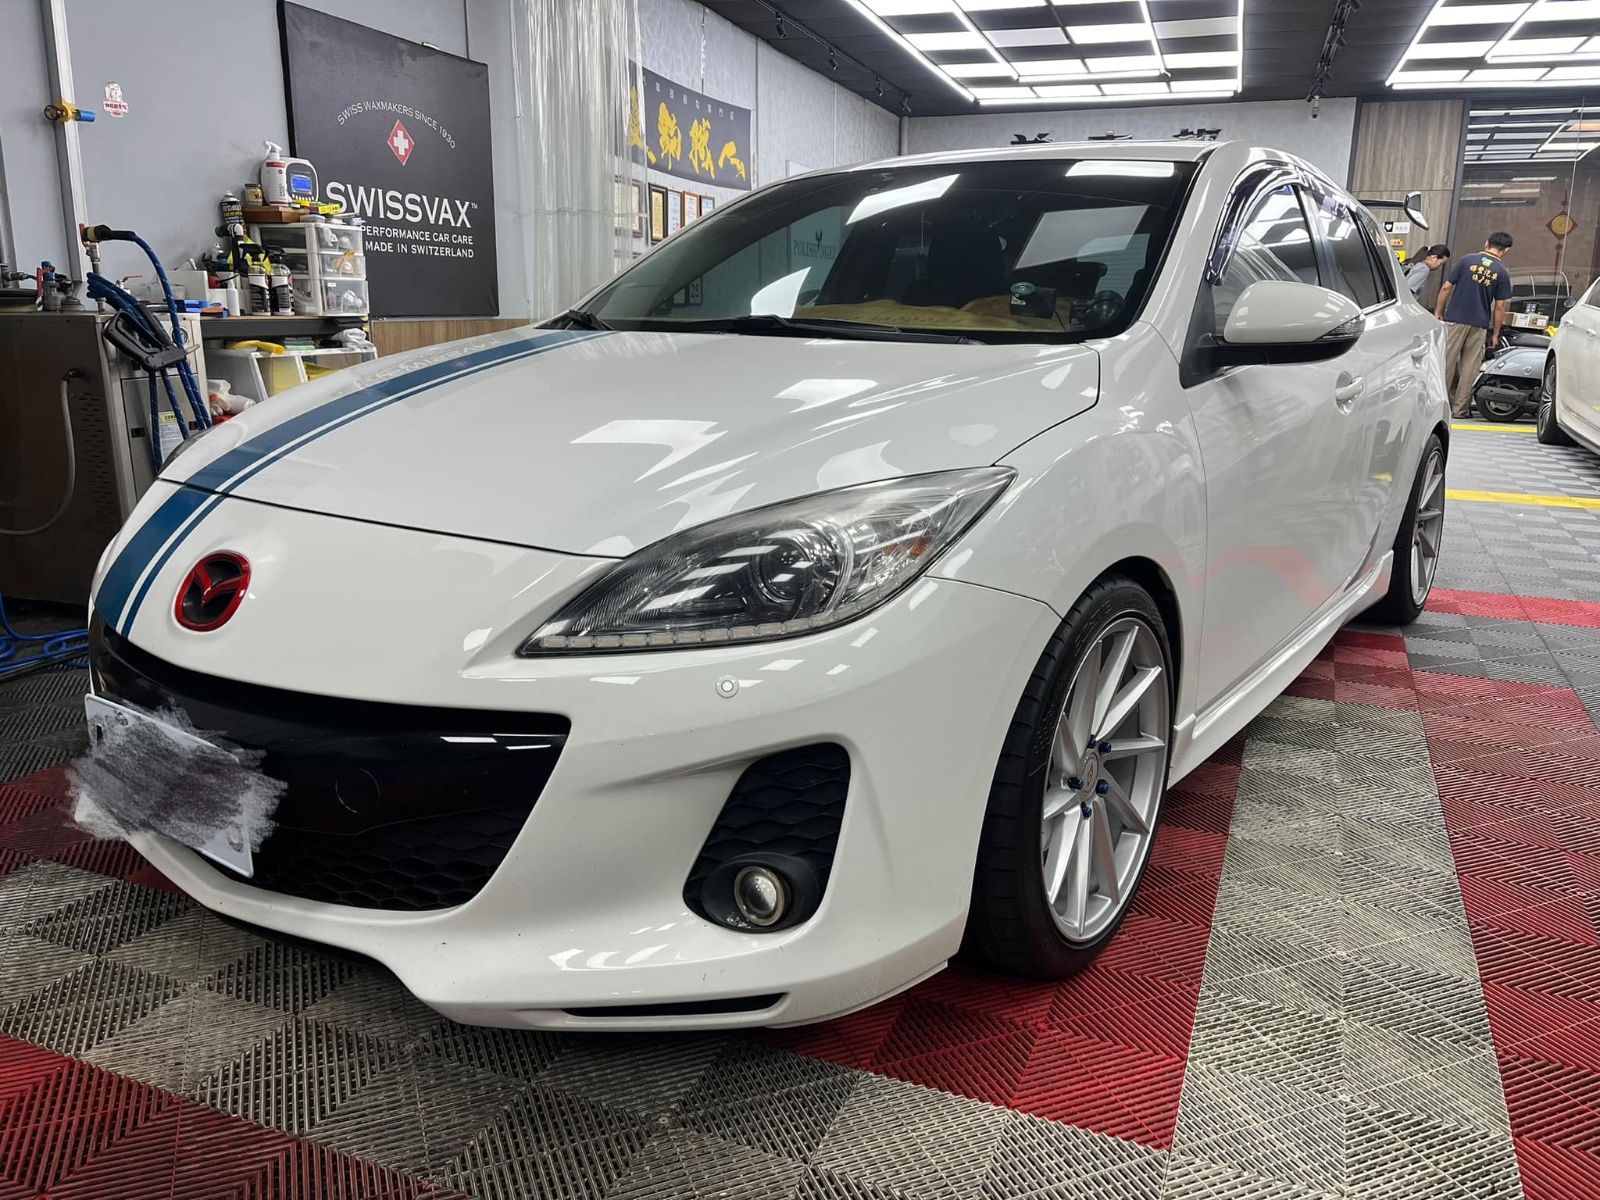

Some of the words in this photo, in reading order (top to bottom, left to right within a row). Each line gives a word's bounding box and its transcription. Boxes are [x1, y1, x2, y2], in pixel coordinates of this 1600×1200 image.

[338, 102, 363, 125] SWISS
[363, 100, 414, 117] WAXMAKERS
[414, 110, 438, 130] SINCE
[439, 126, 456, 149] 1930
[326, 181, 472, 229] SWISSVAX
[365, 240, 394, 253] MADE
[397, 243, 408, 254] IN
[411, 244, 474, 258] SWITZERLAND
[432, 232, 450, 243] CAR
[451, 234, 474, 245] CARE
